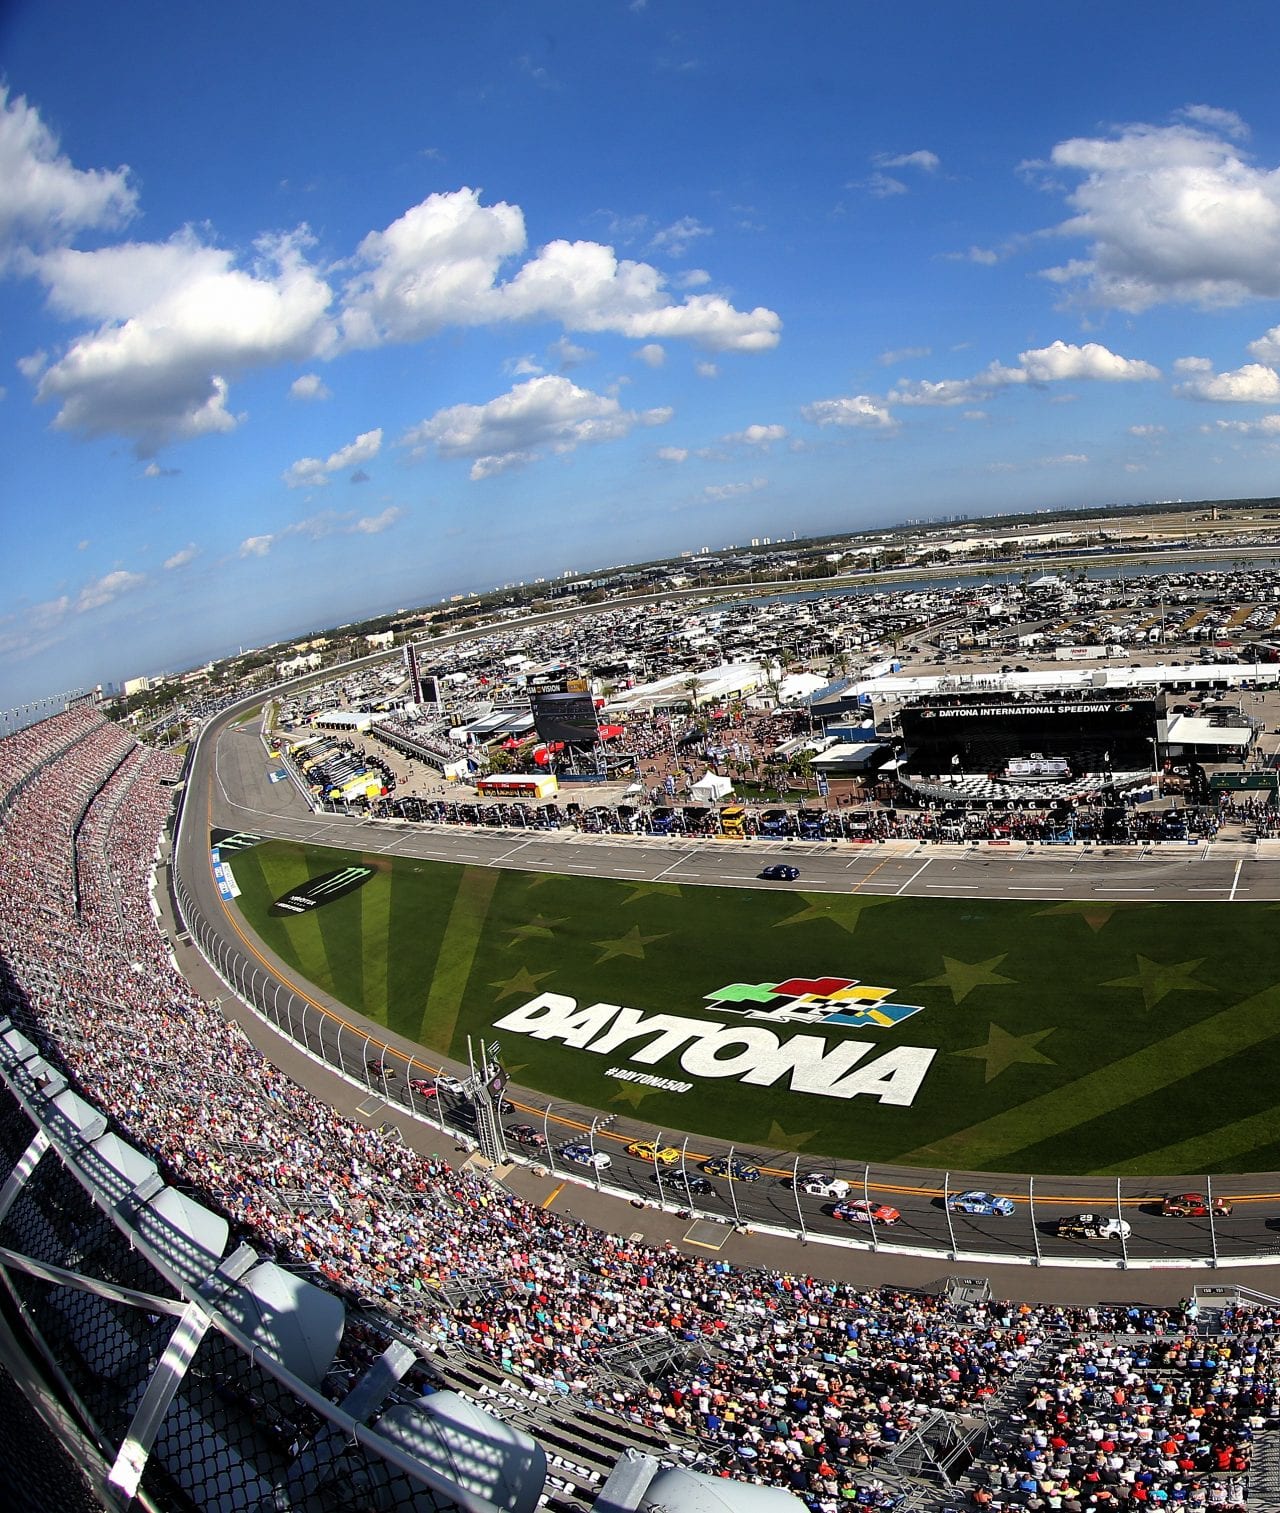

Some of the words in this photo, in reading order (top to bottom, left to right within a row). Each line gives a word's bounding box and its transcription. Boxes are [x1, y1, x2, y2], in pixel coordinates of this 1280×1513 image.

[542, 685, 561, 693] VISION
[939, 708, 978, 717] DAYTONA
[980, 706, 1056, 716] INTERNATIONAL
[1058, 704, 1111, 714] SPEEDWAY
[492, 991, 938, 1108] DAYTONA
[604, 1066, 693, 1094] #DAYTONA500
[974, 1205, 986, 1213] 37
[1084, 1228, 1098, 1238] 62
